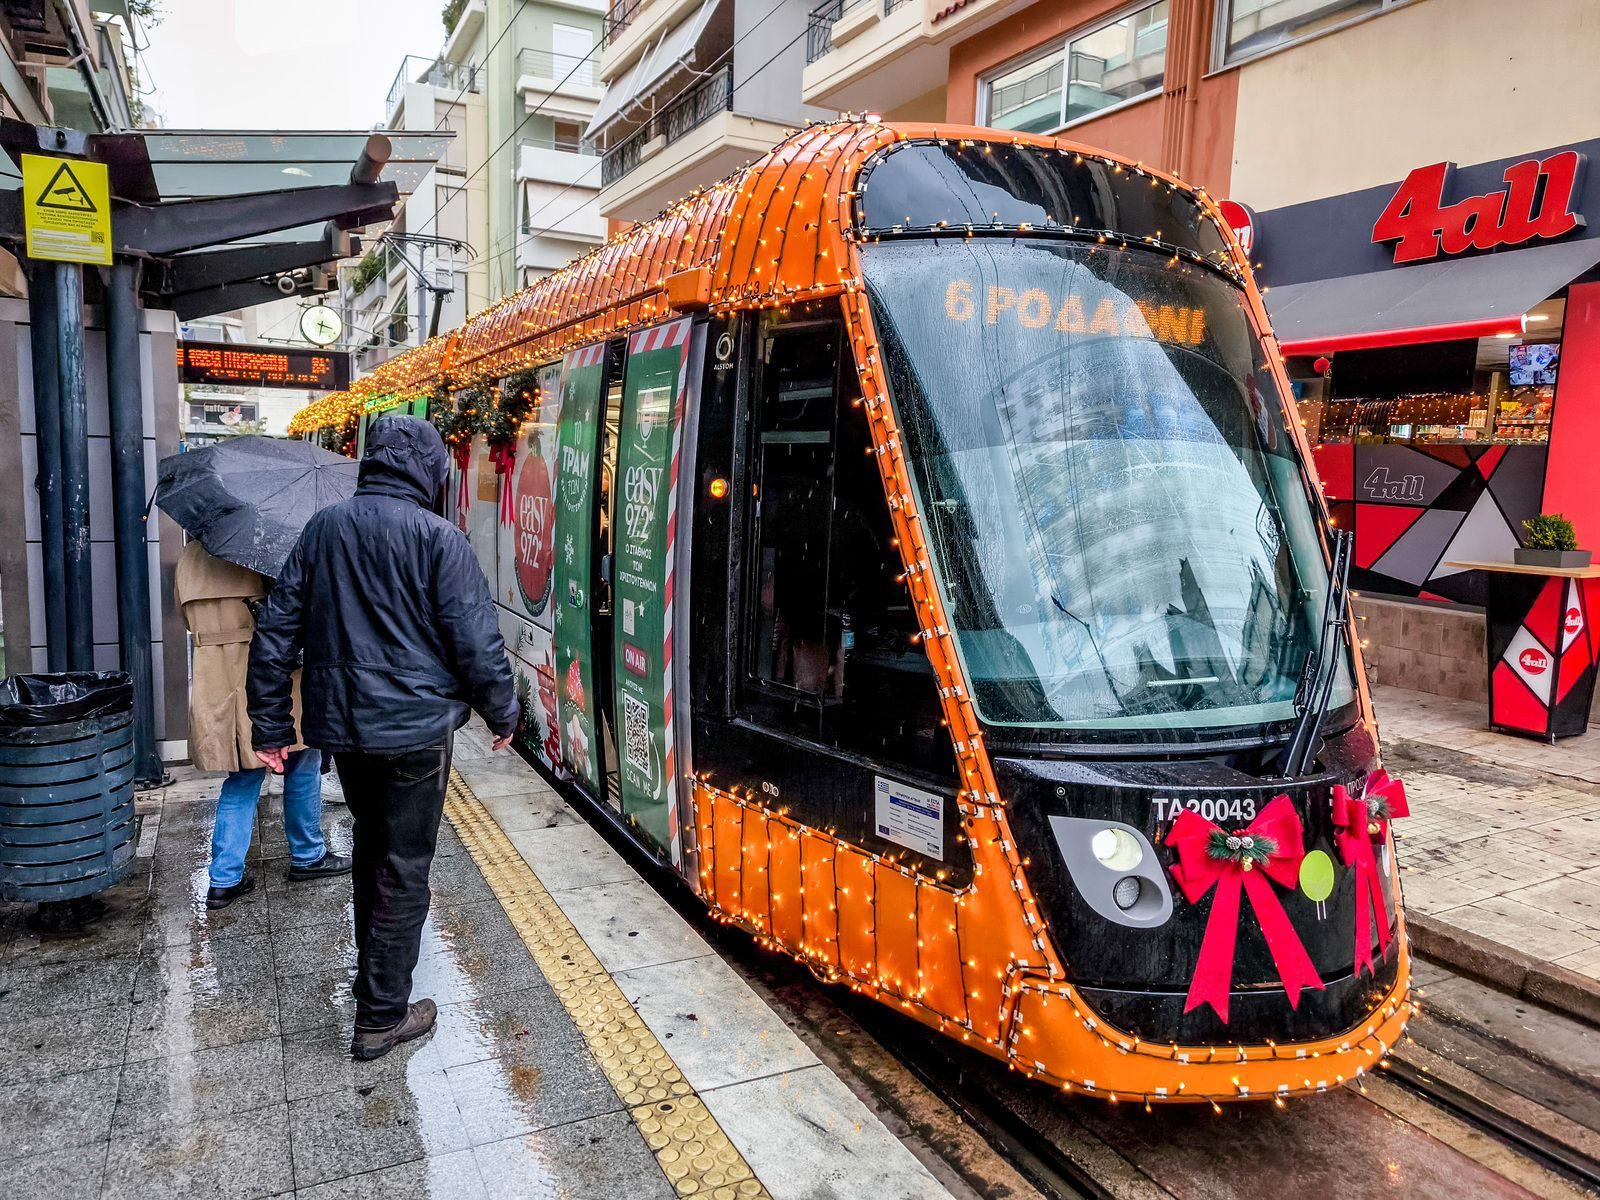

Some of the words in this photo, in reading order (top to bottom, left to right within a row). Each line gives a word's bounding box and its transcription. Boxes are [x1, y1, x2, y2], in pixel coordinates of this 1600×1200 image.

[1371, 151, 1580, 263] 4all
[945, 280, 975, 321] 6
[713, 362, 733, 370] ALSTOM
[562, 445, 590, 480] ΤΡΑΜ
[625, 466, 664, 521] easy
[1363, 467, 1424, 501] 4all
[520, 494, 549, 545] easy
[630, 544, 652, 560] ΣΤΑΘΜΟΣ
[625, 648, 636, 668] ON
[635, 653, 646, 673] AIR
[1521, 654, 1548, 669] 4all
[626, 768, 640, 789] SCAN
[643, 779, 652, 798] ME
